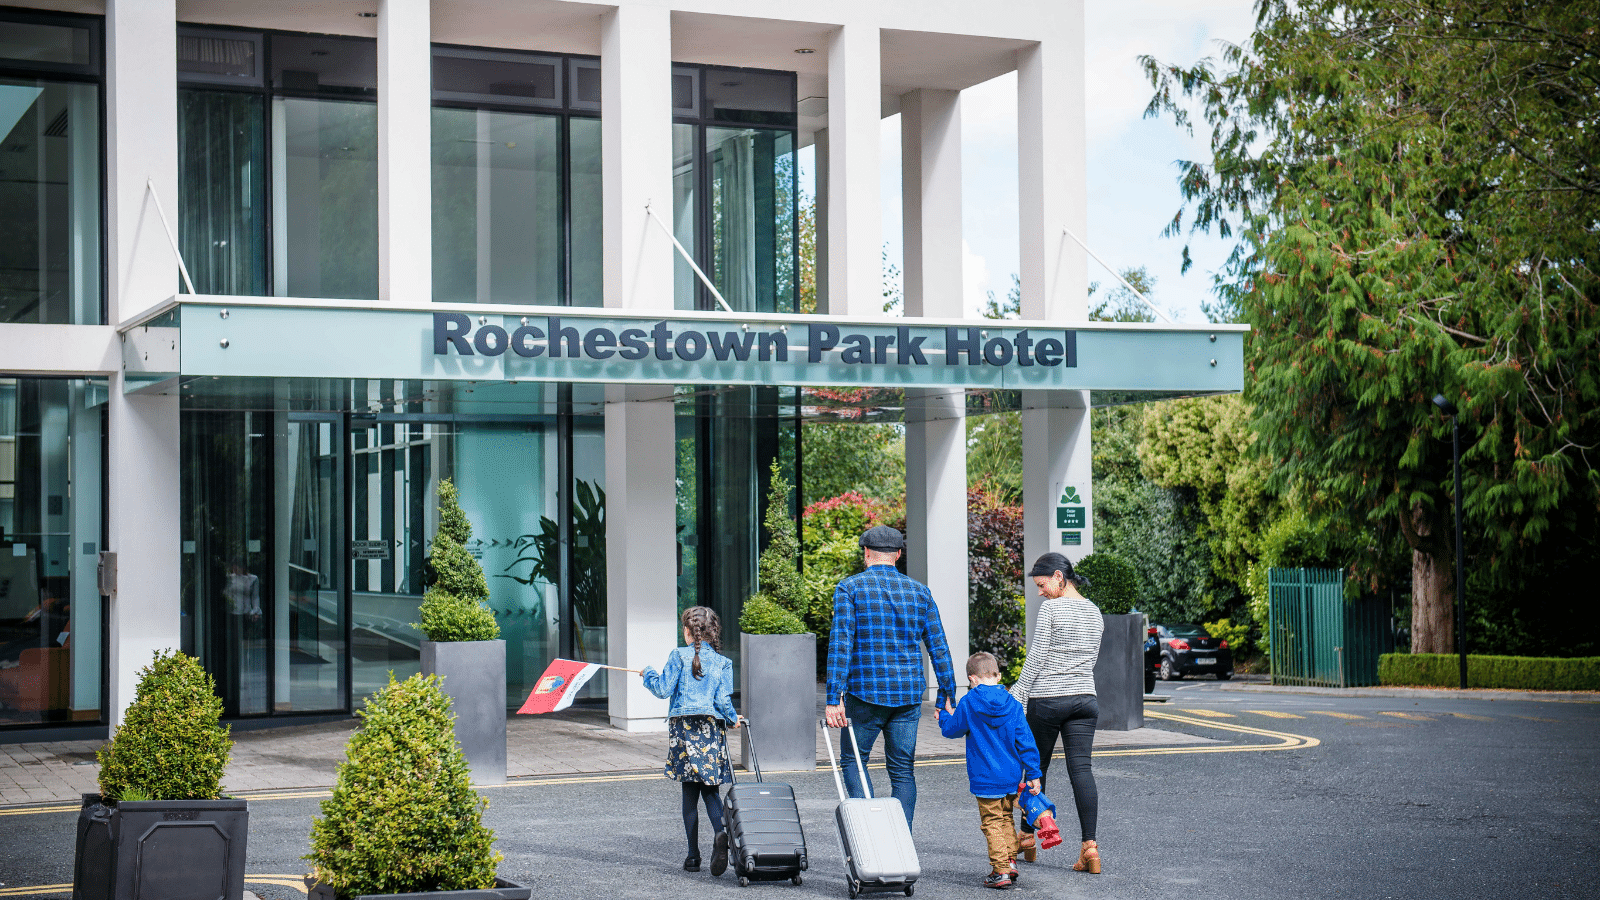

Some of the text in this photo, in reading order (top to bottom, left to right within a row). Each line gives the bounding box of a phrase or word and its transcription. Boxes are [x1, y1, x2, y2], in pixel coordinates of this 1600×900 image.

[433, 312, 1078, 368] Rochestown Park Hotel
